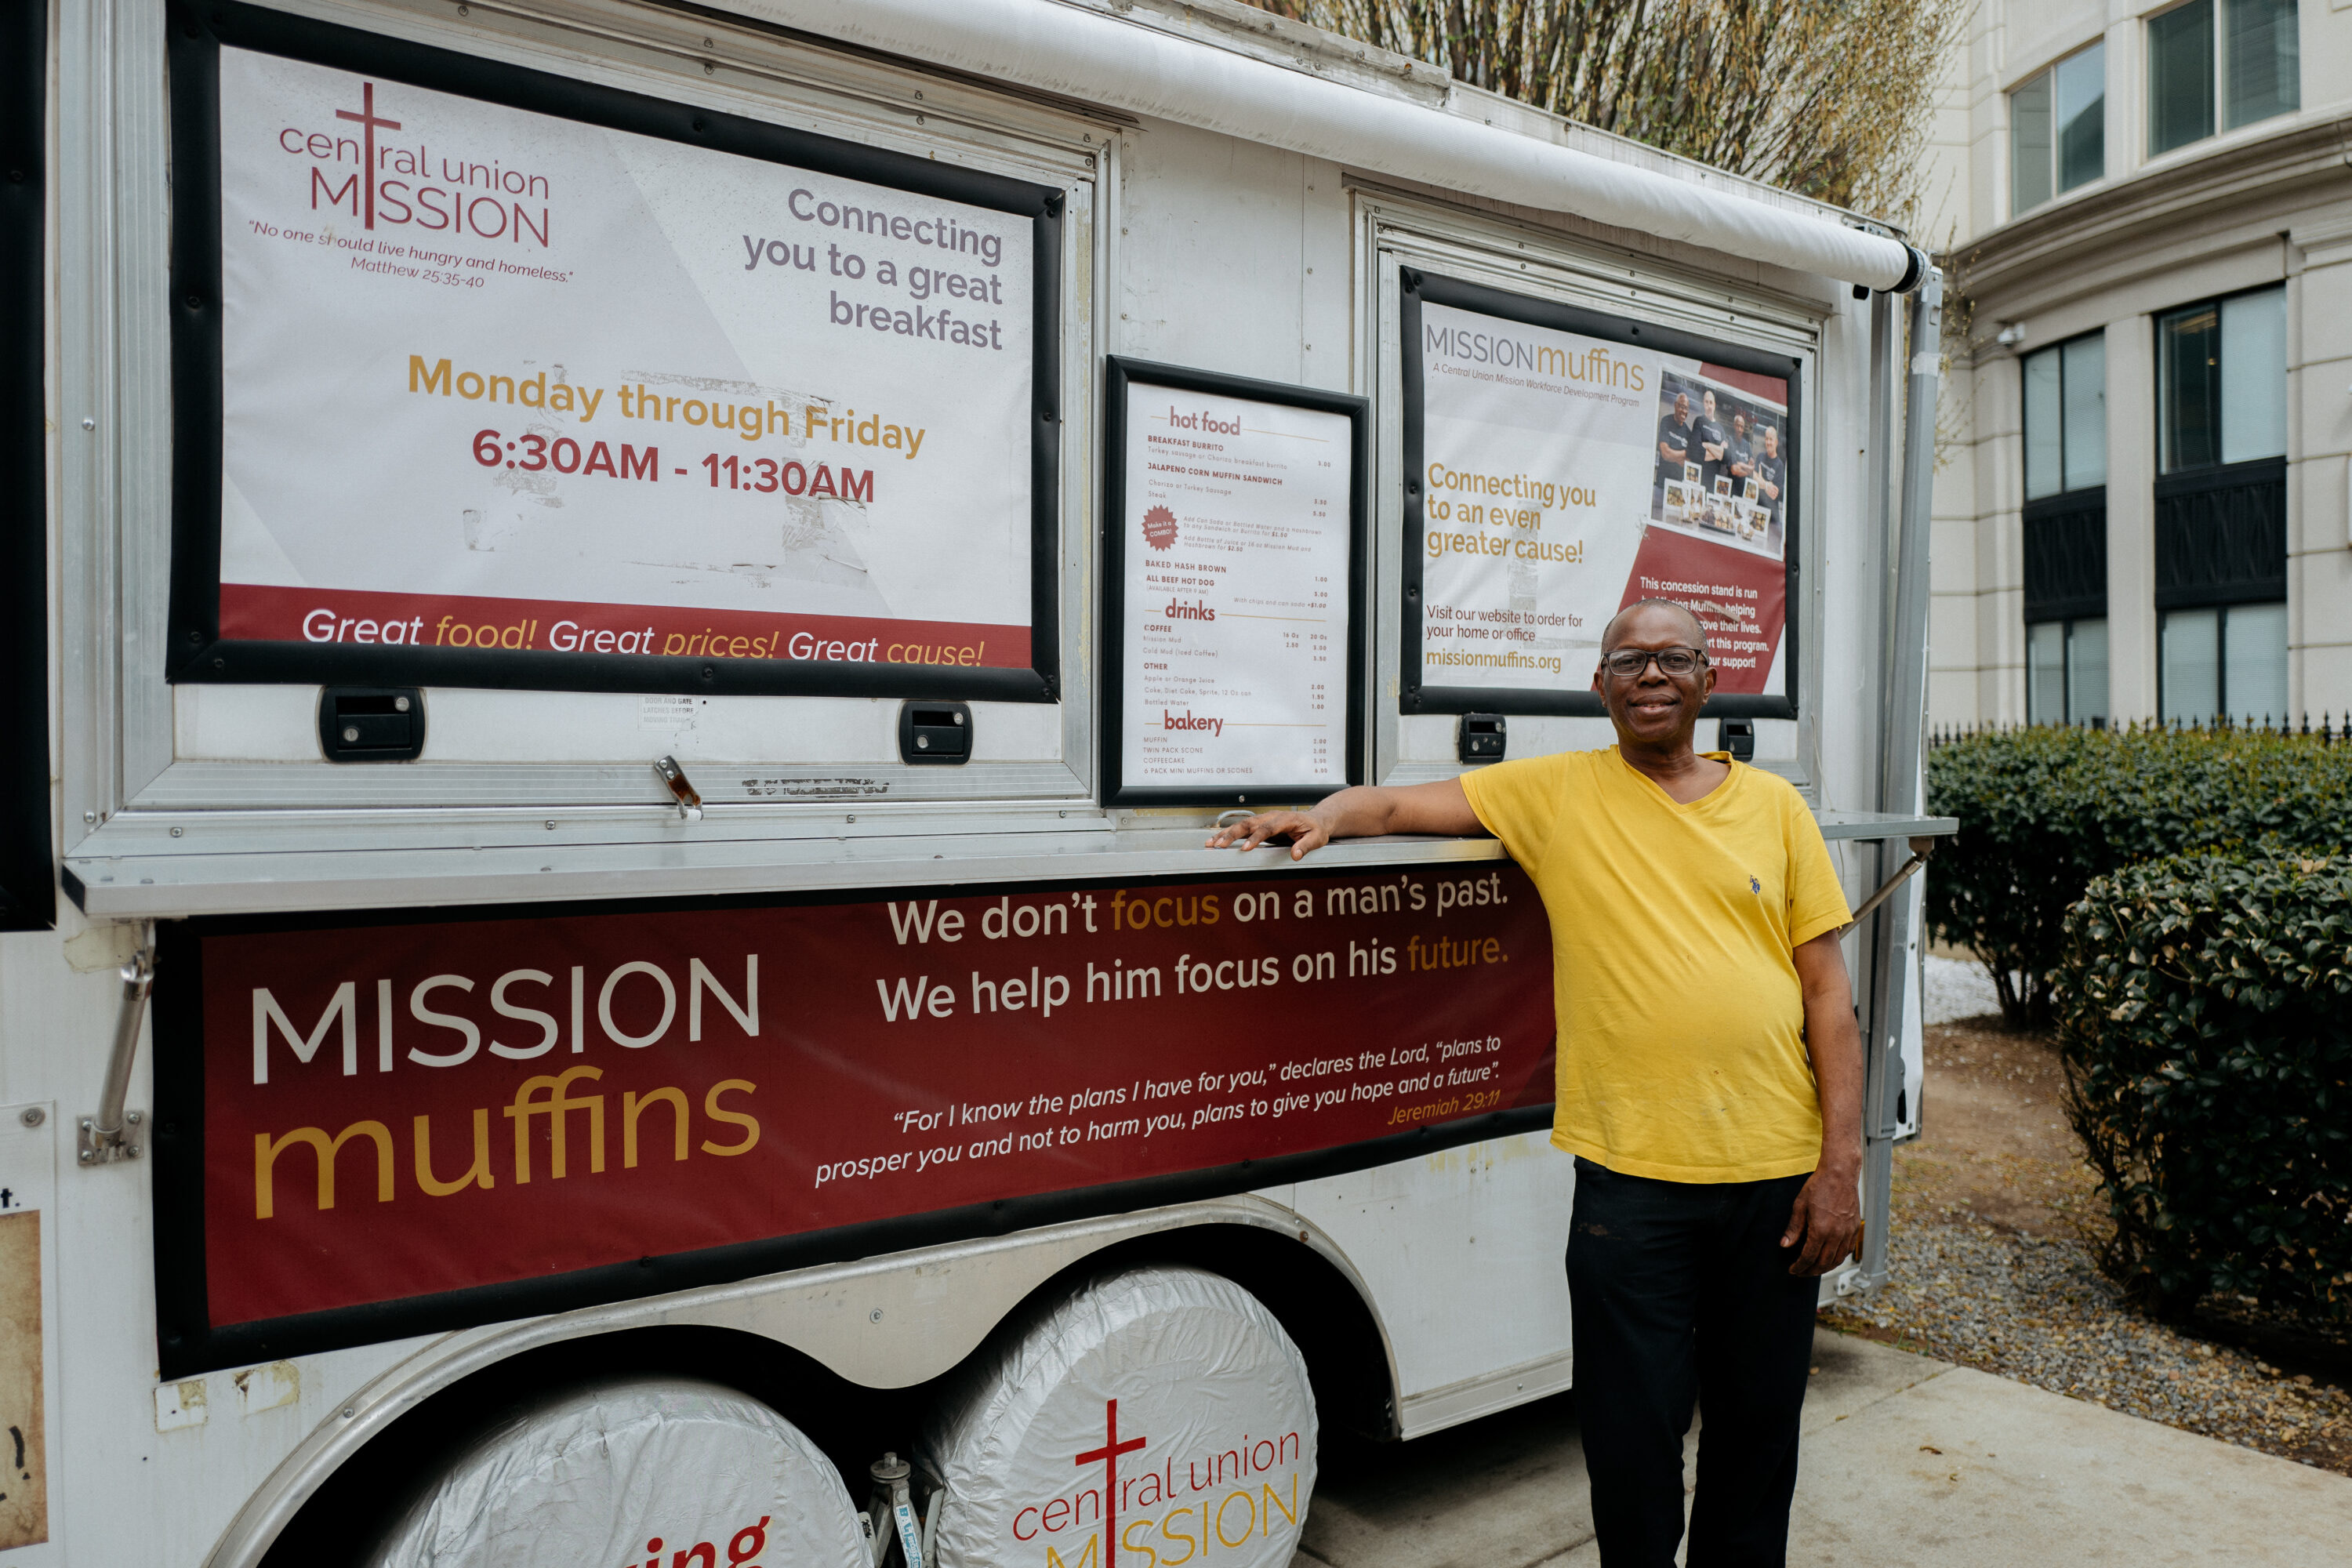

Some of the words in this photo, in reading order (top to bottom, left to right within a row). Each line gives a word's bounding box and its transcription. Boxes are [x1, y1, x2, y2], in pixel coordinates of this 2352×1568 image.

[280, 90, 430, 178] central
[442, 160, 550, 199] union
[311, 166, 549, 248] MISSION
[788, 188, 1001, 267] Connecting
[249, 220, 278, 238] “No
[283, 228, 314, 243] one
[319, 232, 373, 252] should
[379, 241, 405, 256] live
[409, 246, 462, 267] hungry
[466, 257, 494, 270] and
[499, 260, 573, 283] homeless.”
[742, 235, 815, 271] you
[828, 243, 866, 279] to
[877, 260, 898, 286] a
[909, 267, 1002, 305] great
[351, 256, 419, 278] Matthew
[423, 269, 485, 289] 25:35-40
[830, 290, 1002, 350] breakfast
[1433, 363, 1439, 372] A
[1442, 365, 1470, 376] Central
[1472, 370, 1494, 382] Union
[1495, 374, 1524, 387] Mission
[1526, 379, 1562, 394] Workforce
[1563, 386, 1609, 402] Development
[1610, 394, 1639, 408] Program
[408, 354, 604, 422] Monday
[618, 383, 789, 441] through
[804, 405, 926, 459] Friday
[1170, 405, 1198, 430] hot
[1202, 411, 1240, 435] food
[1148, 435, 1189, 447] BREAKFAST
[1192, 441, 1224, 451] BURRITO
[472, 428, 659, 482] 6:30AM
[702, 452, 874, 503] 11:30AM
[1148, 463, 1185, 474] JALAPENO
[1189, 468, 1210, 477] CORN
[1212, 471, 1240, 480] MUFFIN
[1243, 475, 1283, 485] SANDWICH
[1428, 463, 1555, 508] Connecting
[1559, 485, 1596, 511] you
[1428, 495, 1450, 521] to
[1457, 499, 1484, 524] an
[1490, 509, 1541, 530] even
[1145, 560, 1171, 568] BAKED
[1199, 564, 1226, 573] BROWN
[1428, 529, 1511, 558] greater
[1514, 540, 1584, 564] cause!
[1640, 576, 1659, 590] This
[1661, 580, 1709, 594] concession
[1711, 585, 1733, 597] stand
[1736, 586, 1742, 598] is
[1744, 589, 1758, 599] run
[1165, 597, 1215, 621] drinks
[1426, 605, 1453, 619] Visit
[1455, 609, 1475, 622] our
[1478, 608, 1521, 624] website
[1523, 612, 1535, 625] to
[1537, 612, 1566, 626] order
[1568, 614, 1583, 627] for
[1720, 621, 1738, 633] their
[1740, 622, 1762, 633] lives.
[1726, 603, 1755, 619] helping
[303, 608, 423, 645] Great
[435, 615, 537, 650] food!
[550, 620, 655, 655] Great
[662, 628, 779, 659] prices!
[789, 631, 878, 662] Great
[887, 641, 985, 667] cause!
[1426, 624, 1454, 641] your
[1457, 622, 1489, 640] home
[1492, 629, 1504, 641] or
[1506, 625, 1535, 641] office
[1716, 637, 1732, 649] this
[1733, 641, 1769, 653] program.
[1426, 651, 1561, 673] missionmuffins.org
[1708, 658, 1720, 666] our
[1722, 657, 1756, 670] support!
[1164, 710, 1223, 737] bakery
[887, 900, 964, 946] We
[981, 892, 1098, 940] don’t
[1110, 890, 1221, 931] focus
[1232, 891, 1281, 924] on
[1293, 888, 1312, 918] a
[1327, 874, 1427, 915] man’s
[1436, 872, 1509, 917] past.
[875, 974, 954, 1022] We
[971, 965, 1071, 1018] help
[1086, 958, 1161, 1004] him
[1174, 949, 1279, 995] focus
[1292, 951, 1336, 982] on
[1348, 940, 1397, 975] his
[1407, 935, 1509, 972] future.
[252, 953, 760, 1085] MISSION
[894, 1109, 942, 1134] “For
[949, 1105, 955, 1127] I
[962, 1099, 1023, 1125] know
[1029, 1094, 1063, 1116] the
[1069, 1086, 1127, 1115] plans
[1132, 1082, 1139, 1102] I
[1145, 1080, 1192, 1098] have
[1197, 1072, 1225, 1091] for
[1228, 1062, 1276, 1094] you,”
[1279, 1056, 1353, 1081] declares
[1359, 1050, 1385, 1069] the
[1390, 1044, 1430, 1065] Lord,
[1436, 1037, 1482, 1062] “plans
[1486, 1035, 1501, 1051] to
[1388, 1099, 1458, 1125] Jeremiah
[1463, 1089, 1501, 1111] 29:11
[254, 1065, 761, 1220] muffins
[815, 1149, 912, 1189] prosper
[916, 1144, 962, 1172] you
[969, 1133, 1012, 1160] and
[1019, 1127, 1052, 1152] not
[1059, 1126, 1080, 1145] to
[1087, 1116, 1138, 1141] harm
[1145, 1110, 1185, 1137] you,
[1192, 1102, 1243, 1128] plans
[1250, 1098, 1266, 1116] to
[1272, 1092, 1309, 1118] give
[1315, 1087, 1345, 1112] you
[1350, 1080, 1394, 1102] hope
[1398, 1072, 1429, 1093] and
[1433, 1074, 1443, 1088] a
[1013, 1411, 1176, 1541] central
[1189, 1432, 1299, 1491] union
